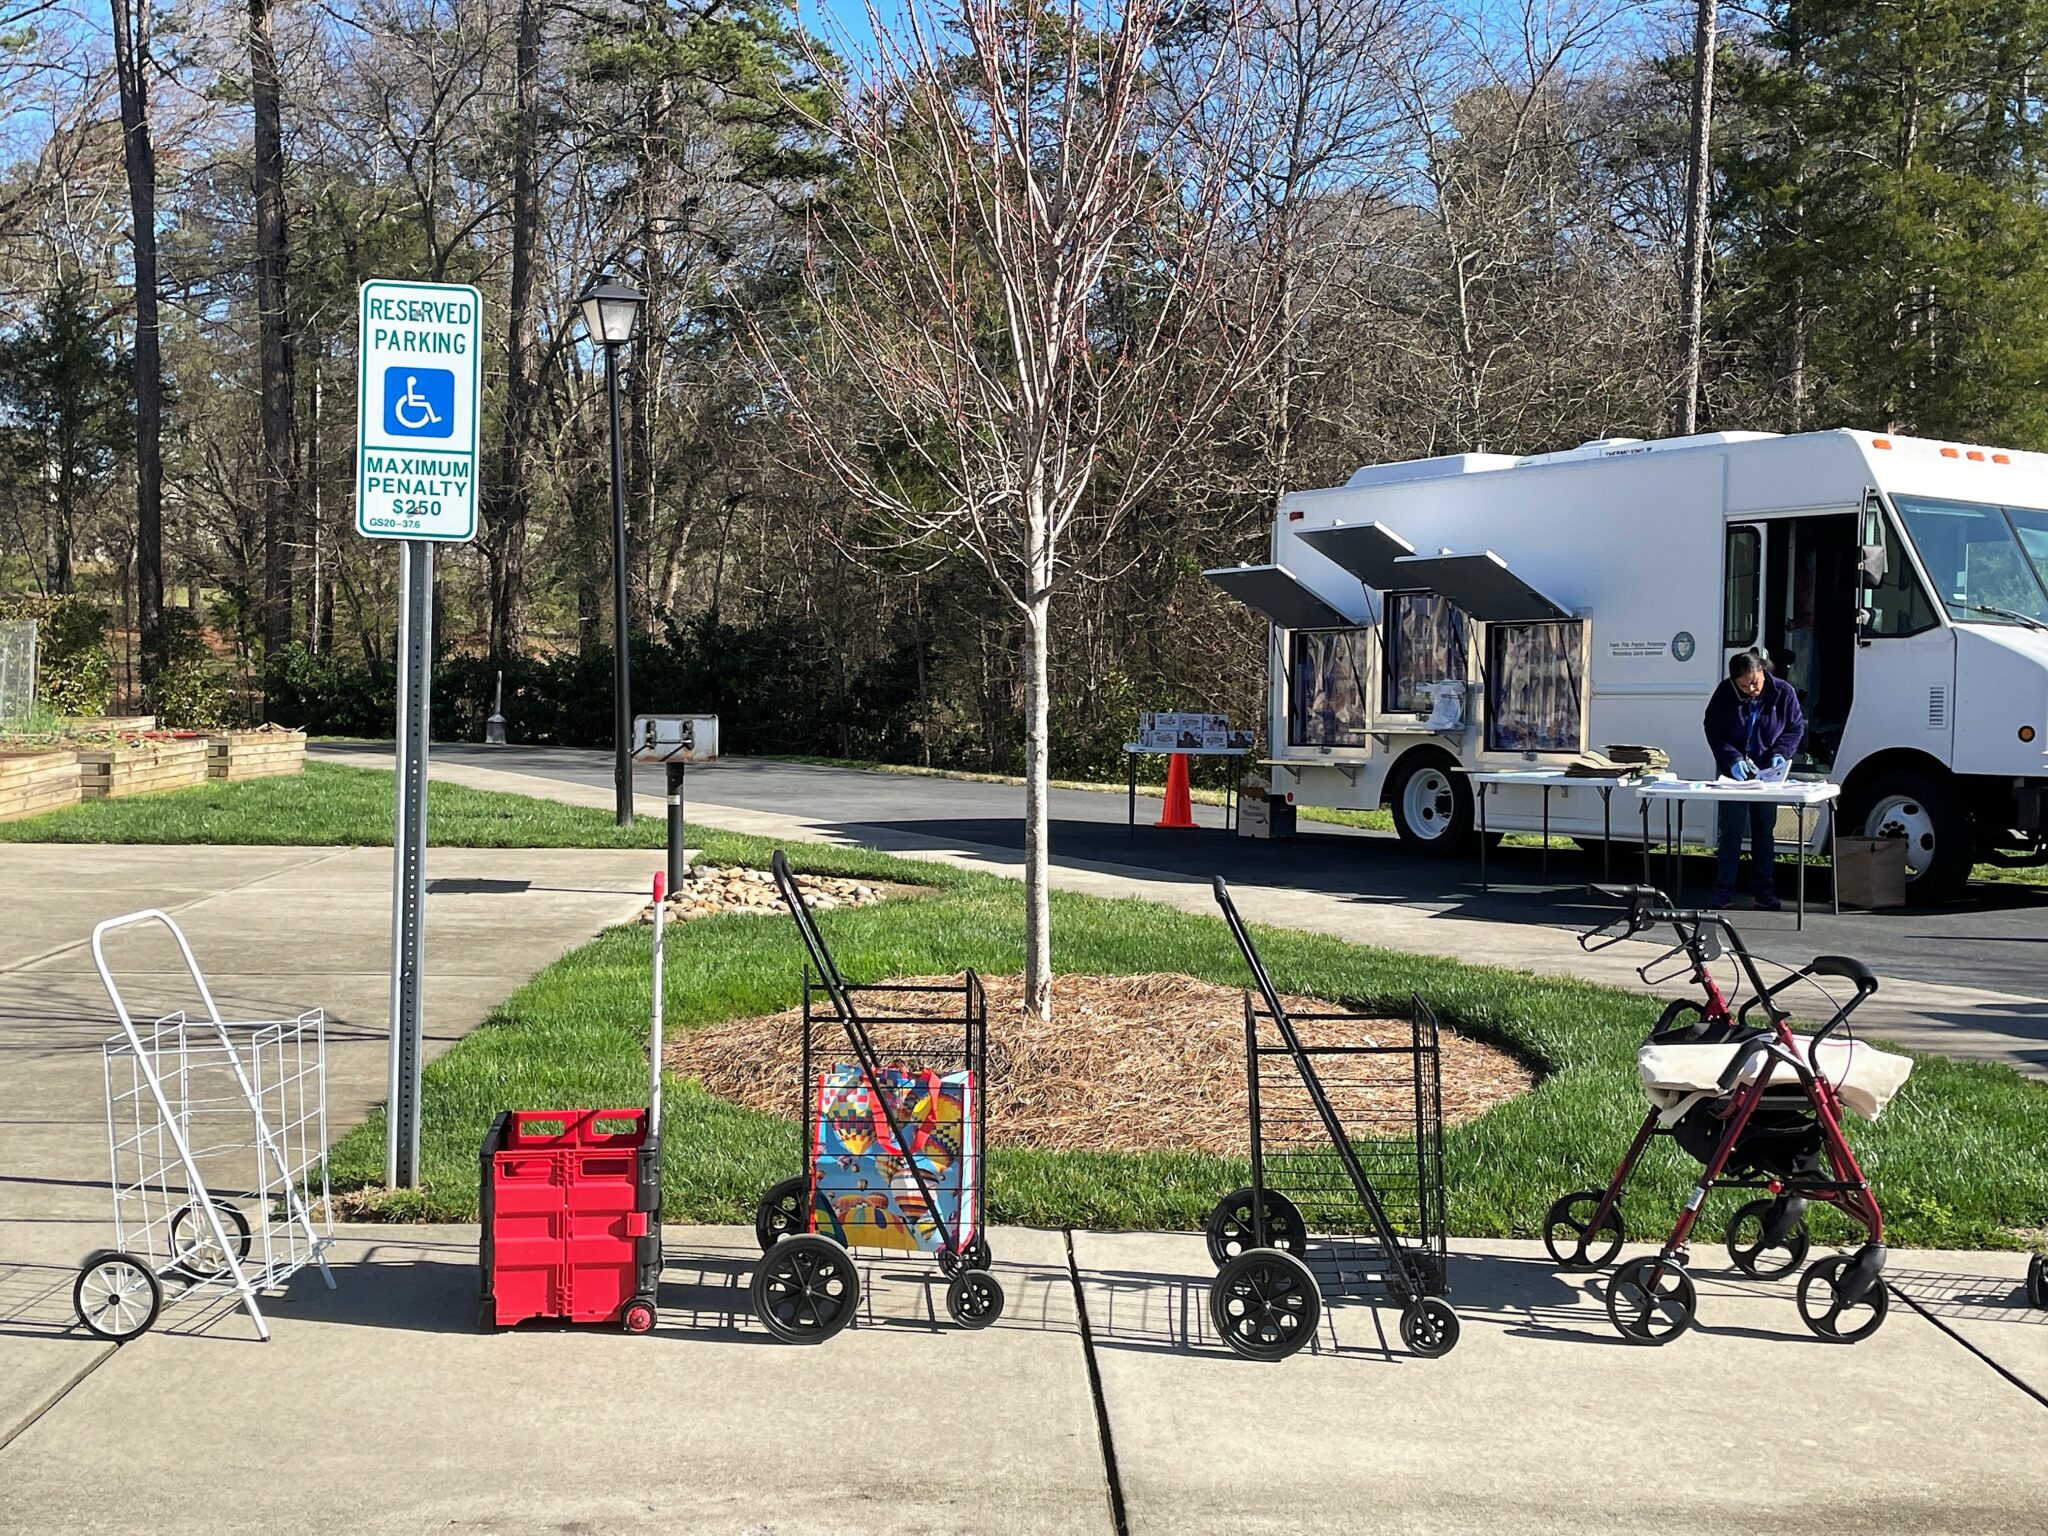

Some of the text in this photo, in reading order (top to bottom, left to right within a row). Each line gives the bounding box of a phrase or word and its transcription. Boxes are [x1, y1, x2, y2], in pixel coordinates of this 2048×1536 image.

[371, 298, 471, 325] RESERVED
[375, 329, 466, 355] PARKING
[367, 457, 469, 478] MAXIMUM
[368, 477, 467, 497] PENALTY
[393, 498, 442, 516] $250
[369, 518, 421, 529] GS20-37.6
